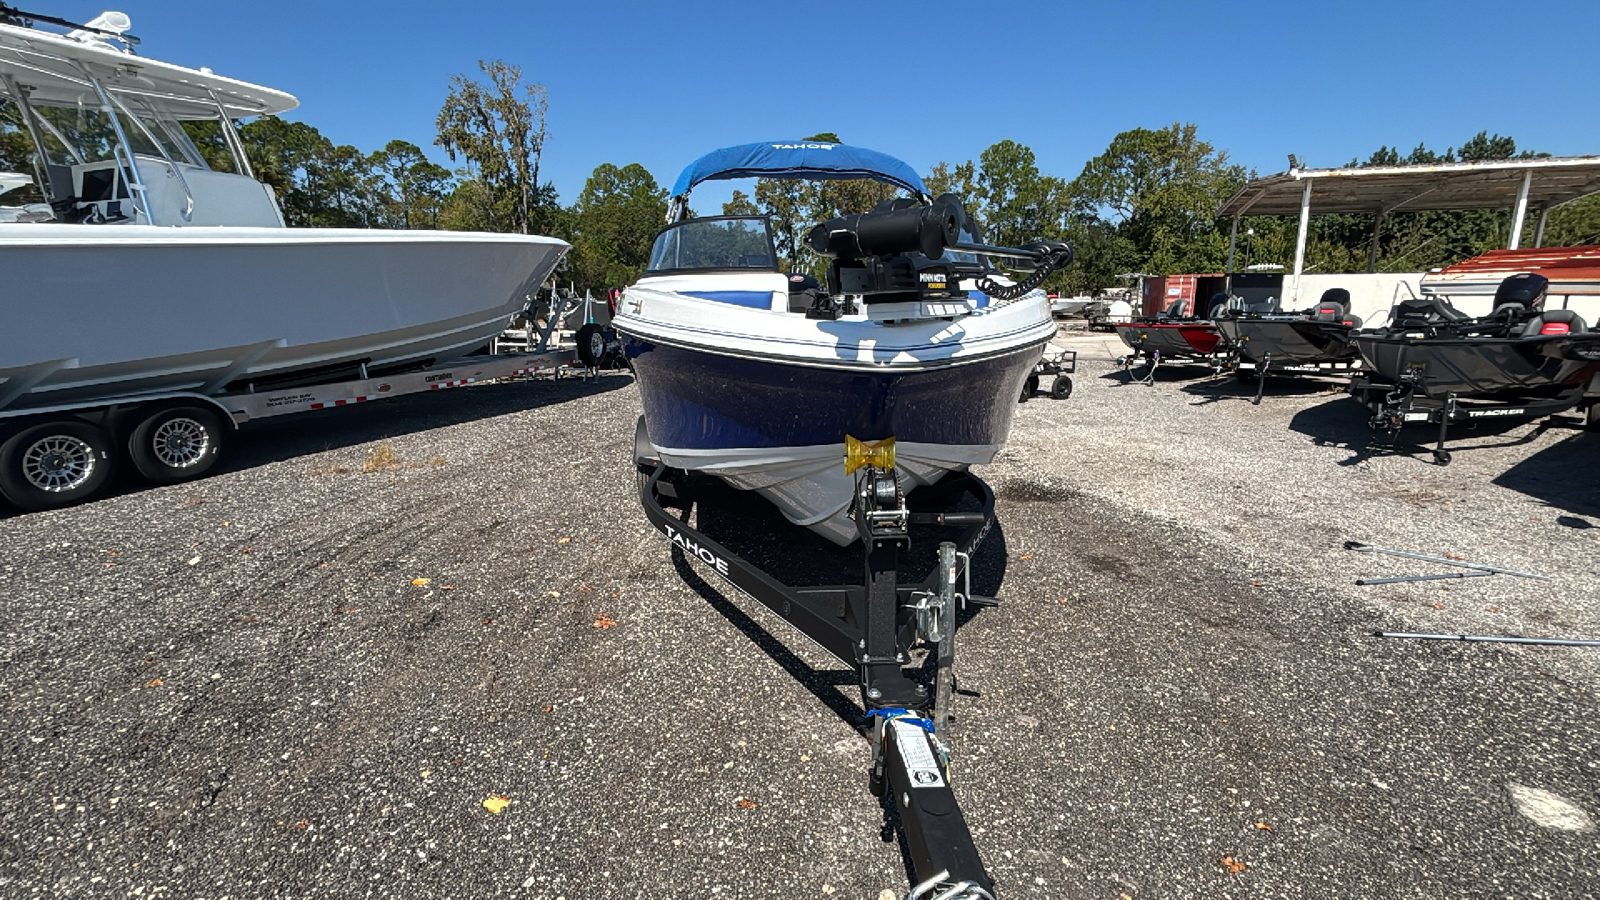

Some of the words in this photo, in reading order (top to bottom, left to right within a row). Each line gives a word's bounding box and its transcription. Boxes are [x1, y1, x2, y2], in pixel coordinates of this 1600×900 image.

[772, 143, 833, 151] TAHOE
[1468, 409, 1524, 417] TRACKER
[664, 524, 729, 576] TAHOE
